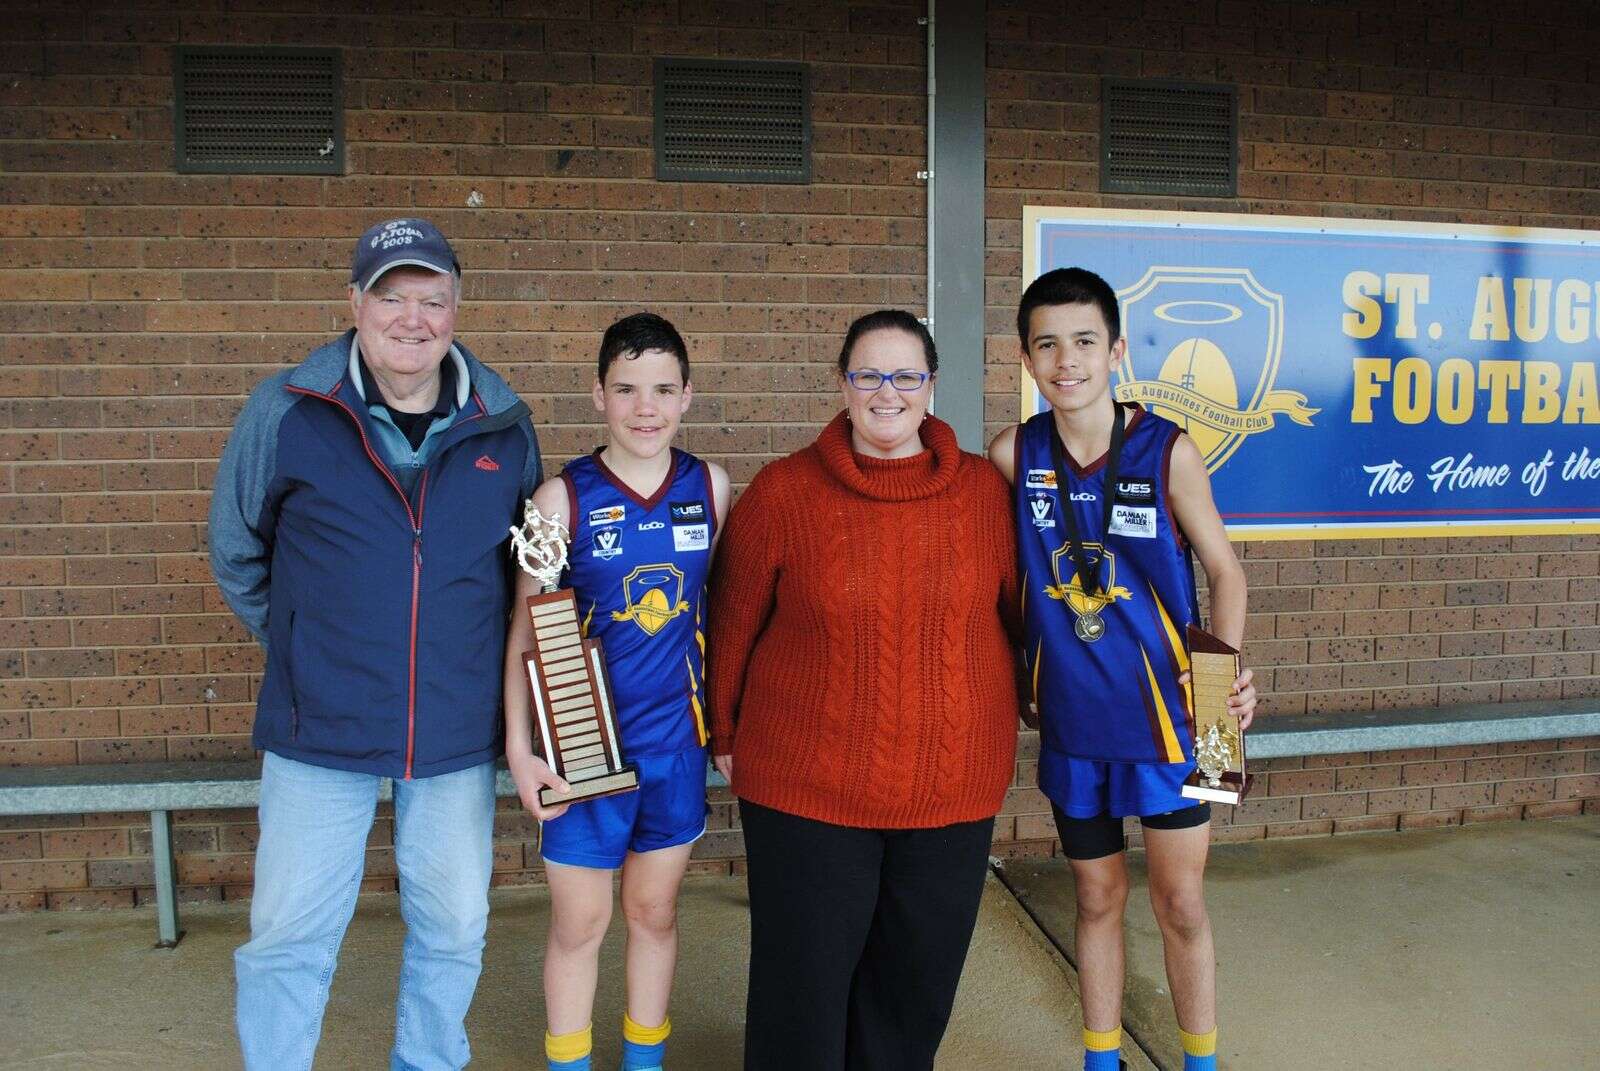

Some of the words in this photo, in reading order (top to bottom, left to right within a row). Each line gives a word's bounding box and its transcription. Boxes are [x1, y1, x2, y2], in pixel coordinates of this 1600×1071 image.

[1342, 271, 1442, 340] ST.
[1469, 276, 1600, 344] AUG
[1121, 388, 1138, 400] St.
[1142, 385, 1200, 412] Augustines
[1202, 406, 1243, 428] Football
[1246, 417, 1268, 429] Club
[1351, 357, 1600, 425] FOOTBA
[1119, 483, 1151, 494] UES
[1363, 459, 1415, 497] The
[1426, 452, 1511, 493] Home
[1521, 448, 1554, 497] of
[1561, 446, 1600, 481] the
[1116, 511, 1147, 519] DAMIAN
[1124, 518, 1148, 526] MILLER
